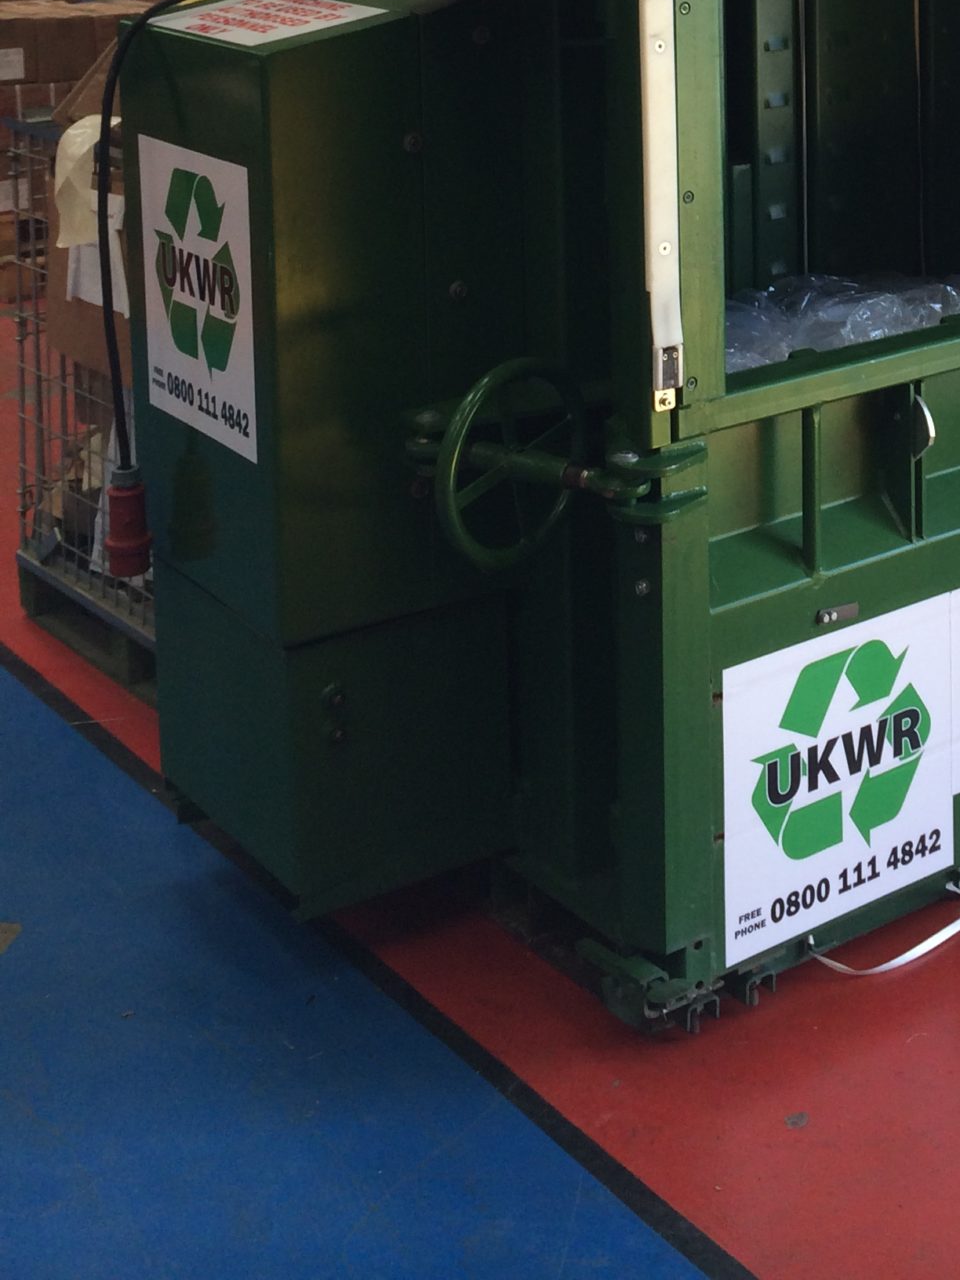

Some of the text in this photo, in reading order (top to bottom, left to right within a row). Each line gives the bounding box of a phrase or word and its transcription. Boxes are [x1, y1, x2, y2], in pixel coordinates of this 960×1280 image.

[160, 240, 235, 315] UKWR
[167, 372, 249, 438] 0800 111 4842
[766, 707, 921, 805] UKWR
[770, 828, 942, 923] 0800 111 4842
[734, 919, 767, 940] PHONE
[738, 907, 762, 925] FREE
